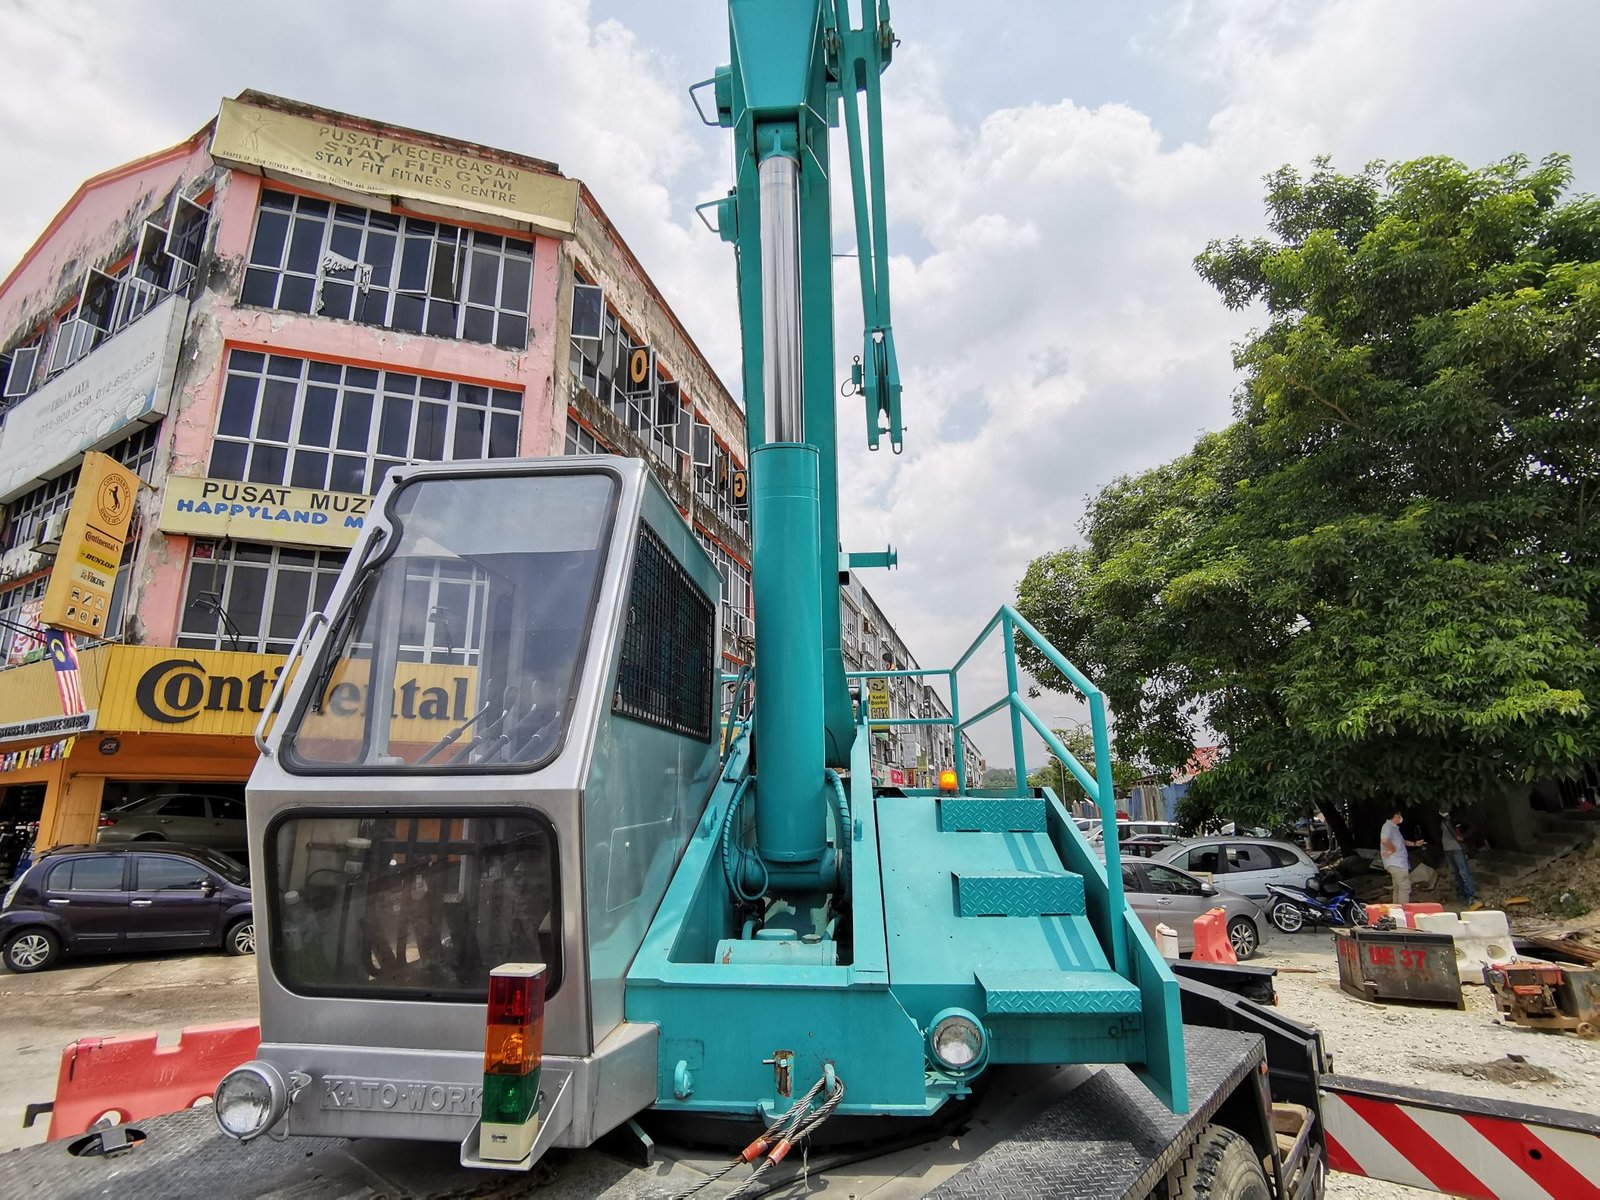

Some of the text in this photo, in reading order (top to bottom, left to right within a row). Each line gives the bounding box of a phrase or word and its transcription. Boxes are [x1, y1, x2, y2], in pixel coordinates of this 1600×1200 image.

[319, 126, 520, 181] PUSAT KECERGASAN
[315, 151, 517, 204] STAY FIT FITNESS CENTRE
[324, 141, 512, 192] STAY FIT GYM
[202, 482, 292, 506] PUSAT
[176, 499, 328, 525] HAPPYLAND
[85, 553, 116, 569] DUNLOP
[86, 571, 106, 588] VIKING
[870, 706, 889, 719] HK
[1399, 948, 1427, 968] 37
[322, 1080, 398, 1110] KATO
